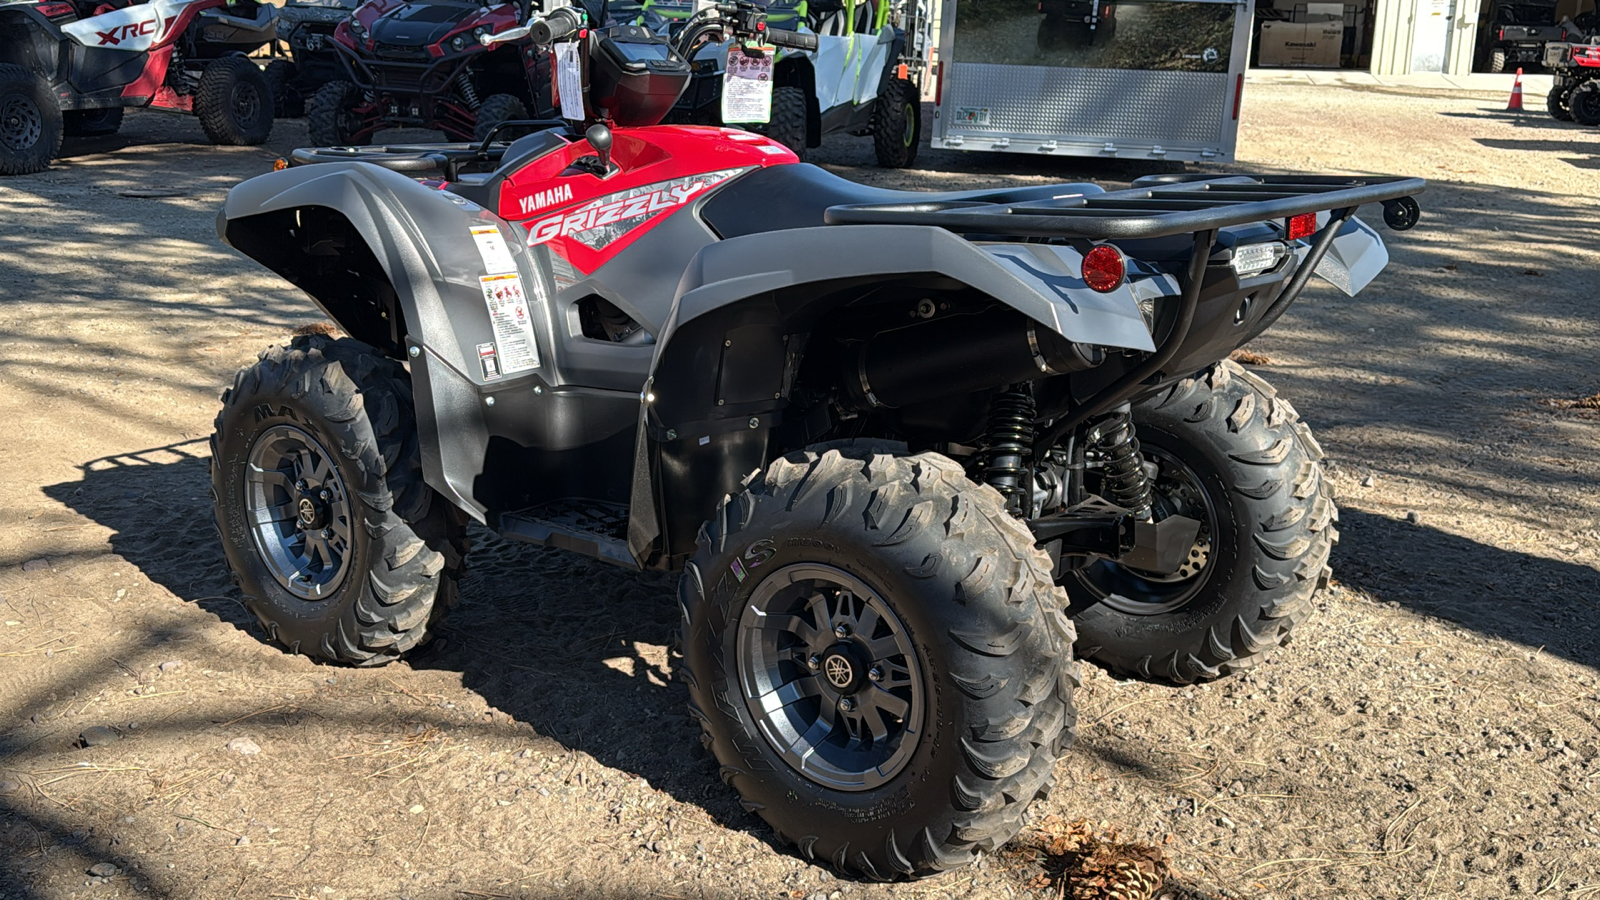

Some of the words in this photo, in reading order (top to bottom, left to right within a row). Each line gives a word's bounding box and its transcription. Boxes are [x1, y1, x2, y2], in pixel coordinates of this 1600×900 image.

[94, 18, 156, 46] XRC
[519, 183, 573, 214] YAMAHA
[526, 180, 705, 247] GRIZZLY
